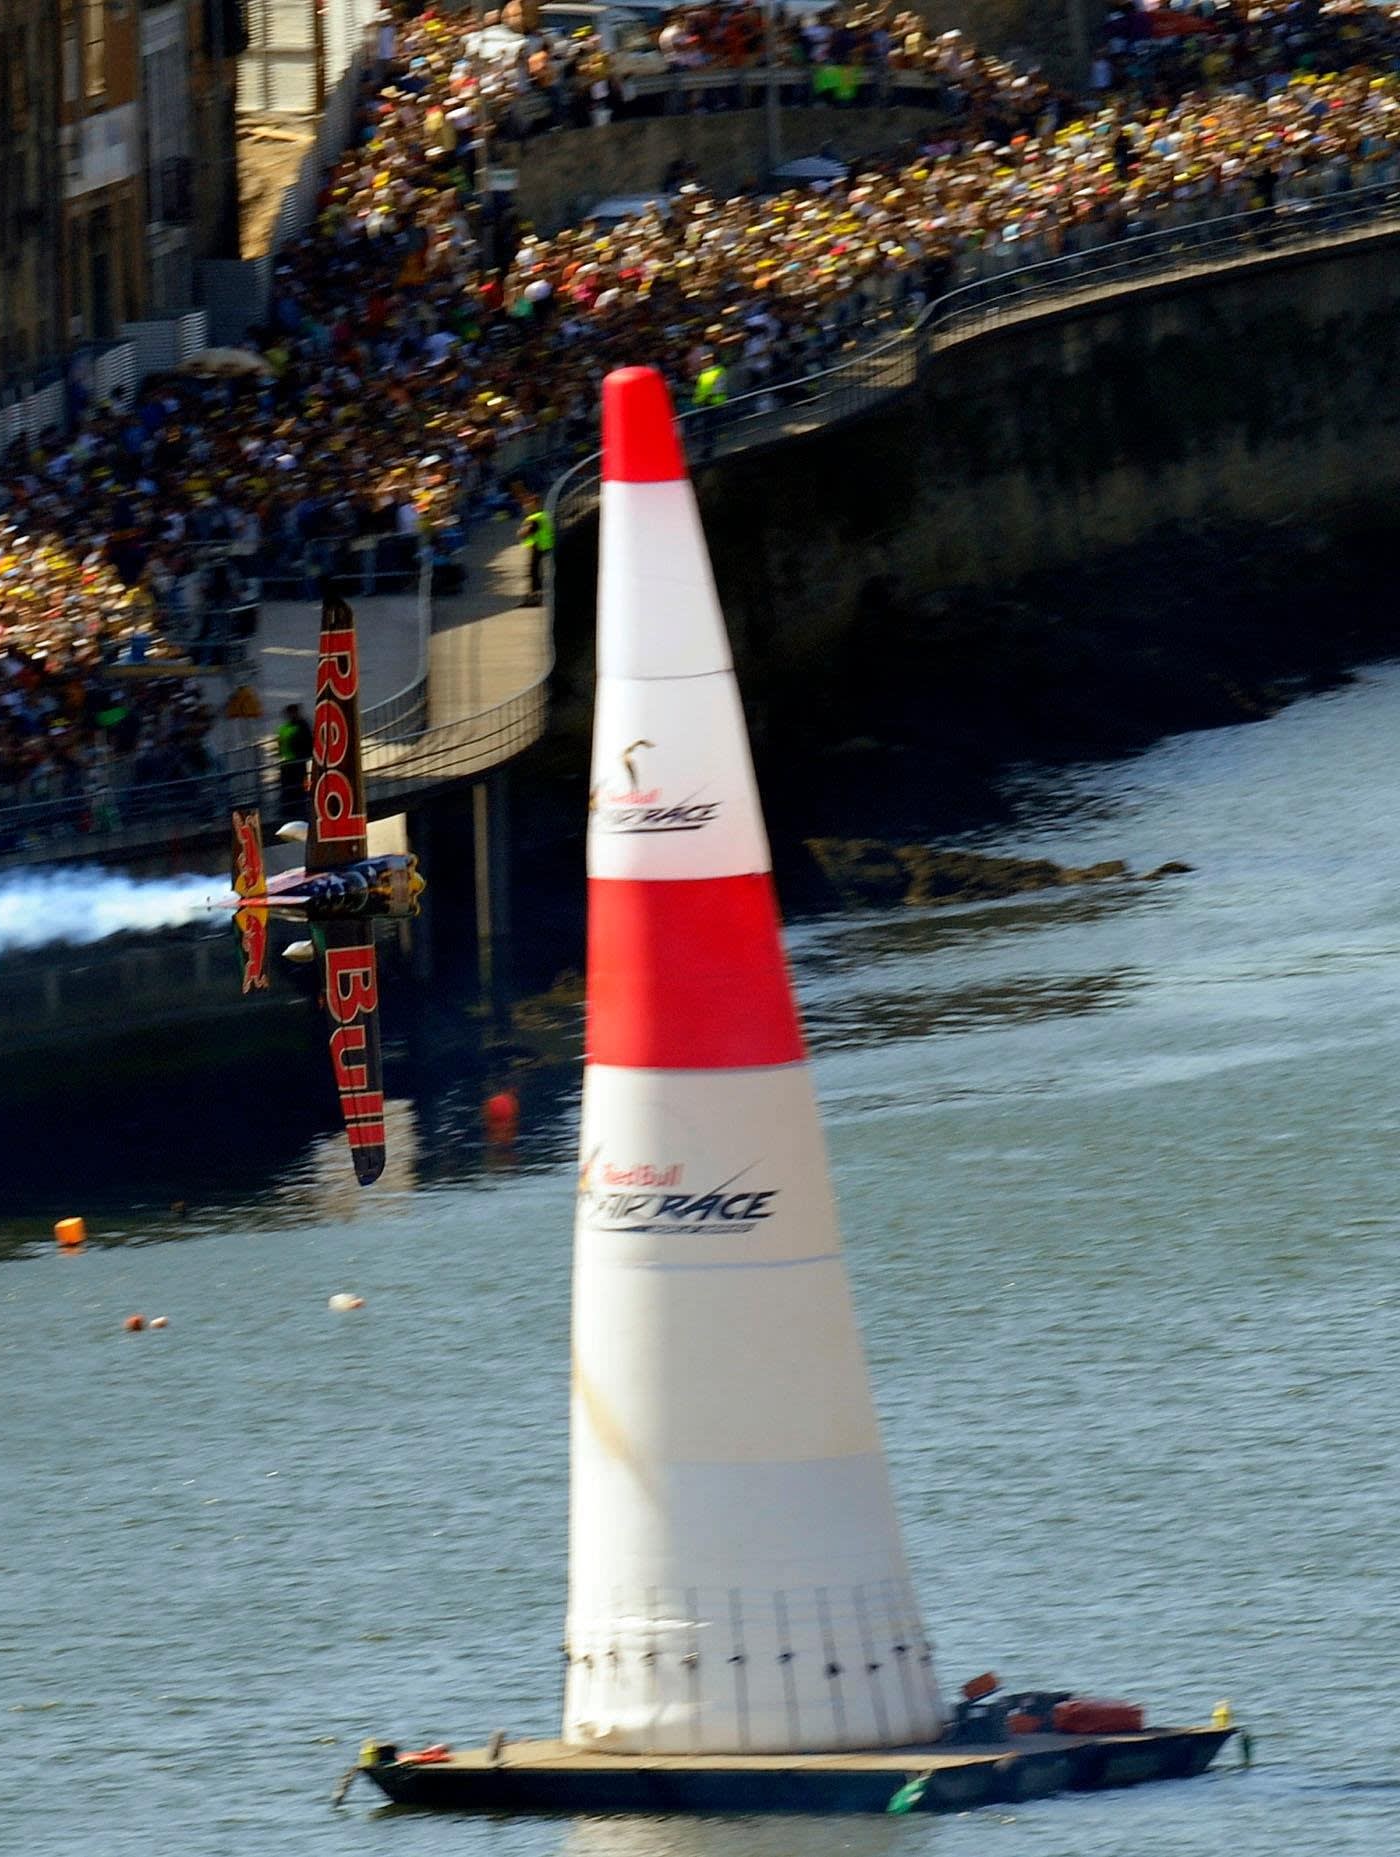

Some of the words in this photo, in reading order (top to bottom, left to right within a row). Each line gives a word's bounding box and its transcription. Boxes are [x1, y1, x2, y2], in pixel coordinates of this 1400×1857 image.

[313, 629, 367, 843] Red
[326, 945, 386, 1149] Bull
[649, 1189, 782, 1222] RACE
